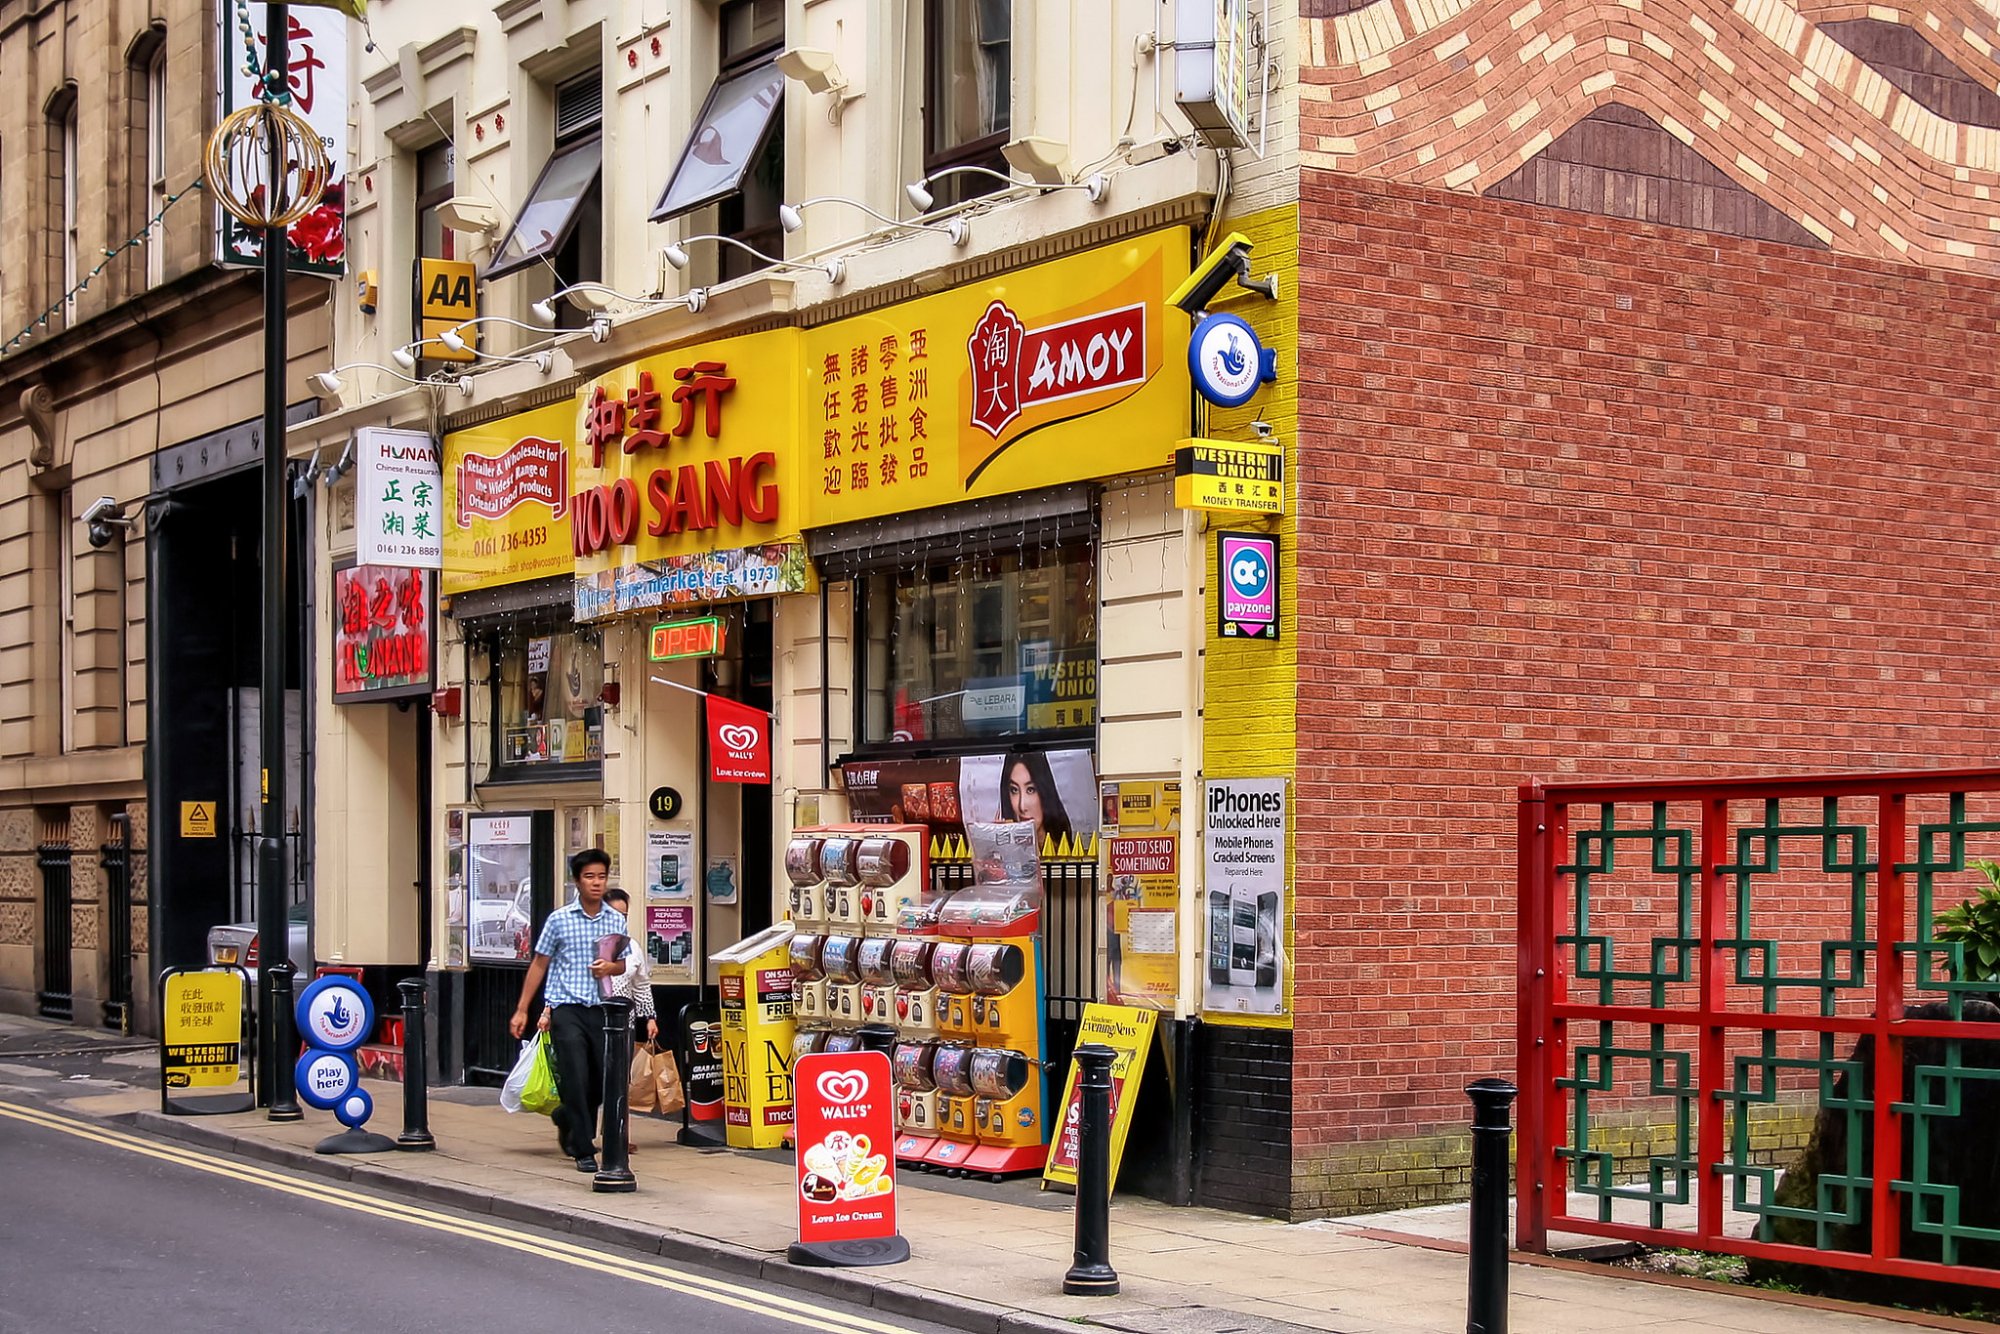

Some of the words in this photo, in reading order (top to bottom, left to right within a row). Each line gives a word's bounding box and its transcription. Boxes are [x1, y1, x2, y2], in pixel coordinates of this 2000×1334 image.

[426, 273, 472, 308] AA
[982, 322, 1010, 418] 淘大
[1028, 327, 1133, 396] AMOY
[879, 334, 898, 486] 零售批發
[908, 328, 928, 479] 亞洲食品
[585, 361, 737, 468] 和生行
[851, 344, 869, 490] 諸君光臨
[823, 353, 841, 495] 無任歡迎
[380, 444, 438, 462] HUNAN
[467, 459, 495, 478] Retailer
[496, 465, 503, 476] &
[504, 444, 546, 471] Wholesaler
[546, 447, 558, 462] for
[1194, 447, 1267, 467] WESTERN
[376, 463, 404, 473] Chinese
[405, 465, 440, 476] Restauran
[1217, 463, 1267, 479] UNION
[475, 478, 487, 493] the
[488, 473, 514, 495] Widest
[515, 464, 538, 479] Range
[539, 465, 548, 478] of
[382, 479, 433, 508] 正宗
[469, 493, 498, 512] Oriental
[499, 485, 518, 510] Food
[519, 480, 552, 498] Products
[570, 477, 638, 557] WOO
[648, 452, 778, 538] SANG
[1203, 495, 1233, 506] MONEY
[1235, 498, 1278, 511] TRANSFER
[382, 511, 436, 540] 湘菜
[377, 544, 397, 554] 0161
[401, 545, 416, 555] 236
[419, 547, 440, 556] 8889
[474, 538, 496, 557] 0161
[500, 526, 547, 553] 236-4353
[711, 572, 738, 588] (Est.
[742, 566, 778, 582] 1973)
[1228, 602, 1271, 616] payzone
[654, 623, 714, 657] OPEN
[1034, 659, 1096, 680] WESTER
[1056, 677, 1096, 697] UNIO
[984, 693, 1017, 705] LEBARA
[728, 751, 753, 760] WALL'S
[716, 767, 732, 776] Love
[656, 796, 673, 811] 19
[1209, 786, 1281, 813] iPhones
[1209, 814, 1255, 828] Unlocked
[1257, 813, 1280, 828] Here
[1112, 841, 1134, 855] NEED
[1135, 841, 1147, 854] TO
[1149, 840, 1172, 854] SEND
[1215, 836, 1242, 848] Mobile
[1243, 836, 1274, 849] Phones
[1114, 857, 1170, 871] SOMETHING?
[1213, 851, 1245, 863] Cracked
[1245, 852, 1275, 863] Screens
[1224, 866, 1249, 877] Repaired
[1250, 867, 1263, 876] Here
[764, 971, 777, 979] ON
[777, 970, 794, 978] SAL
[725, 1011, 742, 1021] FREE
[324, 1028, 349, 1039] National
[348, 1013, 360, 1035] Lottery
[1082, 1018, 1116, 1038] Evening
[1115, 1022, 1137, 1037] News
[168, 1046, 225, 1057] WESTERN
[185, 1055, 225, 1064] UNION
[725, 1040, 747, 1075] M
[317, 1067, 342, 1079] Play
[1111, 1062, 1126, 1071] ews
[316, 1078, 344, 1089] here
[727, 1075, 747, 1103] EN
[729, 1108, 748, 1123] media
[768, 1106, 794, 1122] med
[821, 1104, 867, 1119] WALL'S
[811, 1214, 834, 1224] Love
[836, 1213, 850, 1222] Ice
[852, 1211, 883, 1221] Cream
